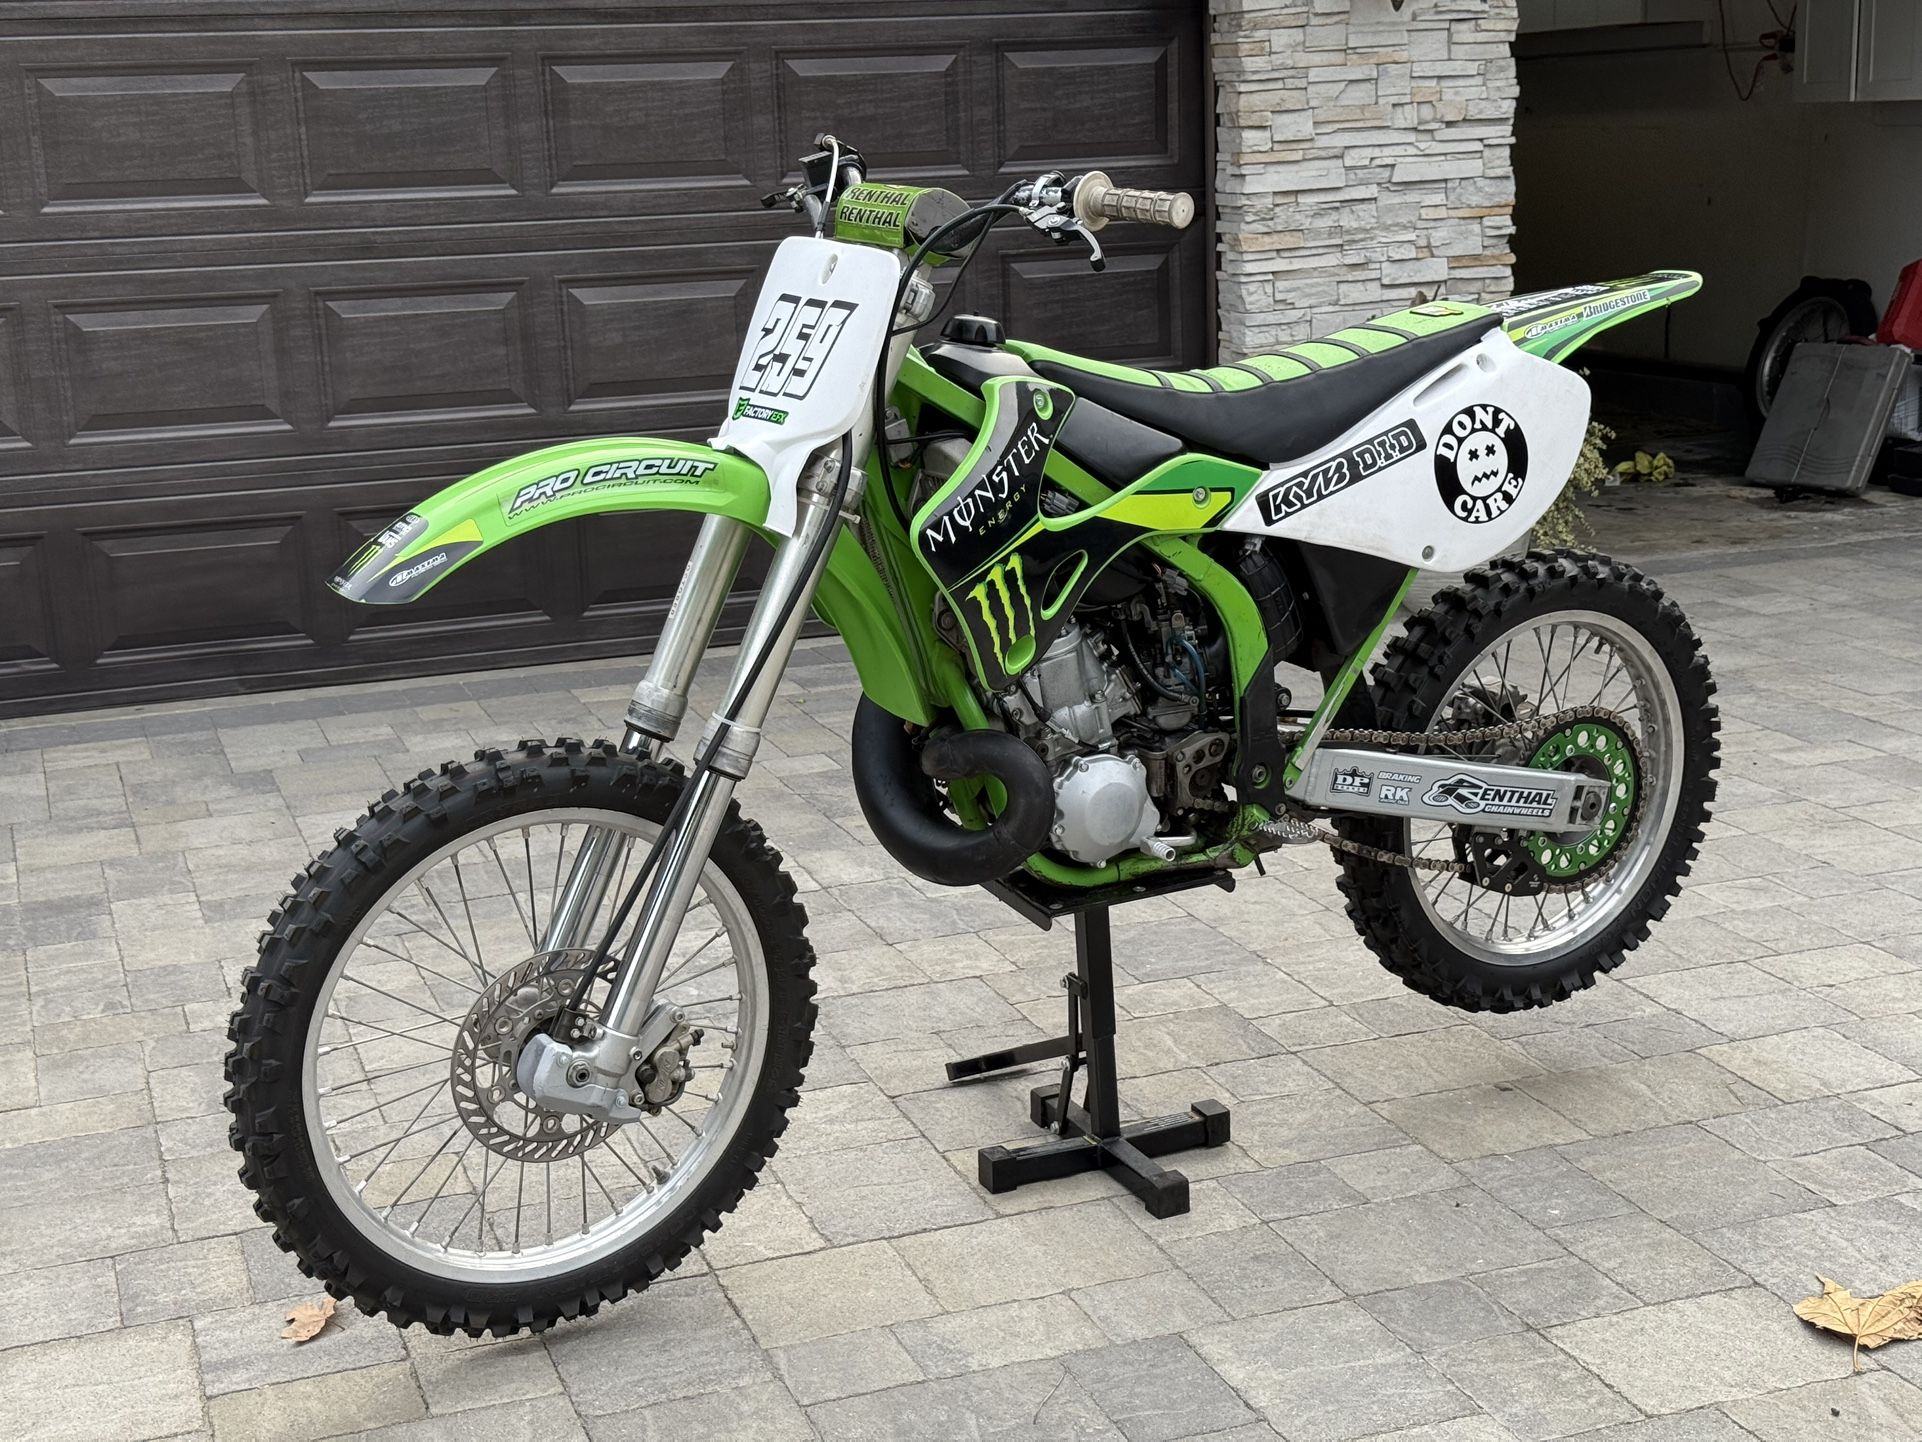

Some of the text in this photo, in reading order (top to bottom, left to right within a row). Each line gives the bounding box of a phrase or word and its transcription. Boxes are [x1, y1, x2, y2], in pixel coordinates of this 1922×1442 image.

[847, 187, 911, 206] RENTHAL
[840, 205, 901, 228] RENTHAL
[1583, 290, 1649, 319] BRIDGESTONE
[1437, 405, 1516, 463] DONT
[508, 457, 719, 514] PRO CIRCUIT
[508, 477, 700, 520] WWW.PROCIRCUIT.COM
[925, 421, 1050, 552] MONSTER
[1268, 458, 1350, 521] KYB
[1453, 472, 1524, 522] CARE
[979, 484, 1028, 536] ENERGY
[1335, 774, 1370, 787] DP
[1379, 771, 1421, 783] BRAKING
[1380, 785, 1411, 801] RK
[1484, 803, 1551, 817] CHAINWHEELS
